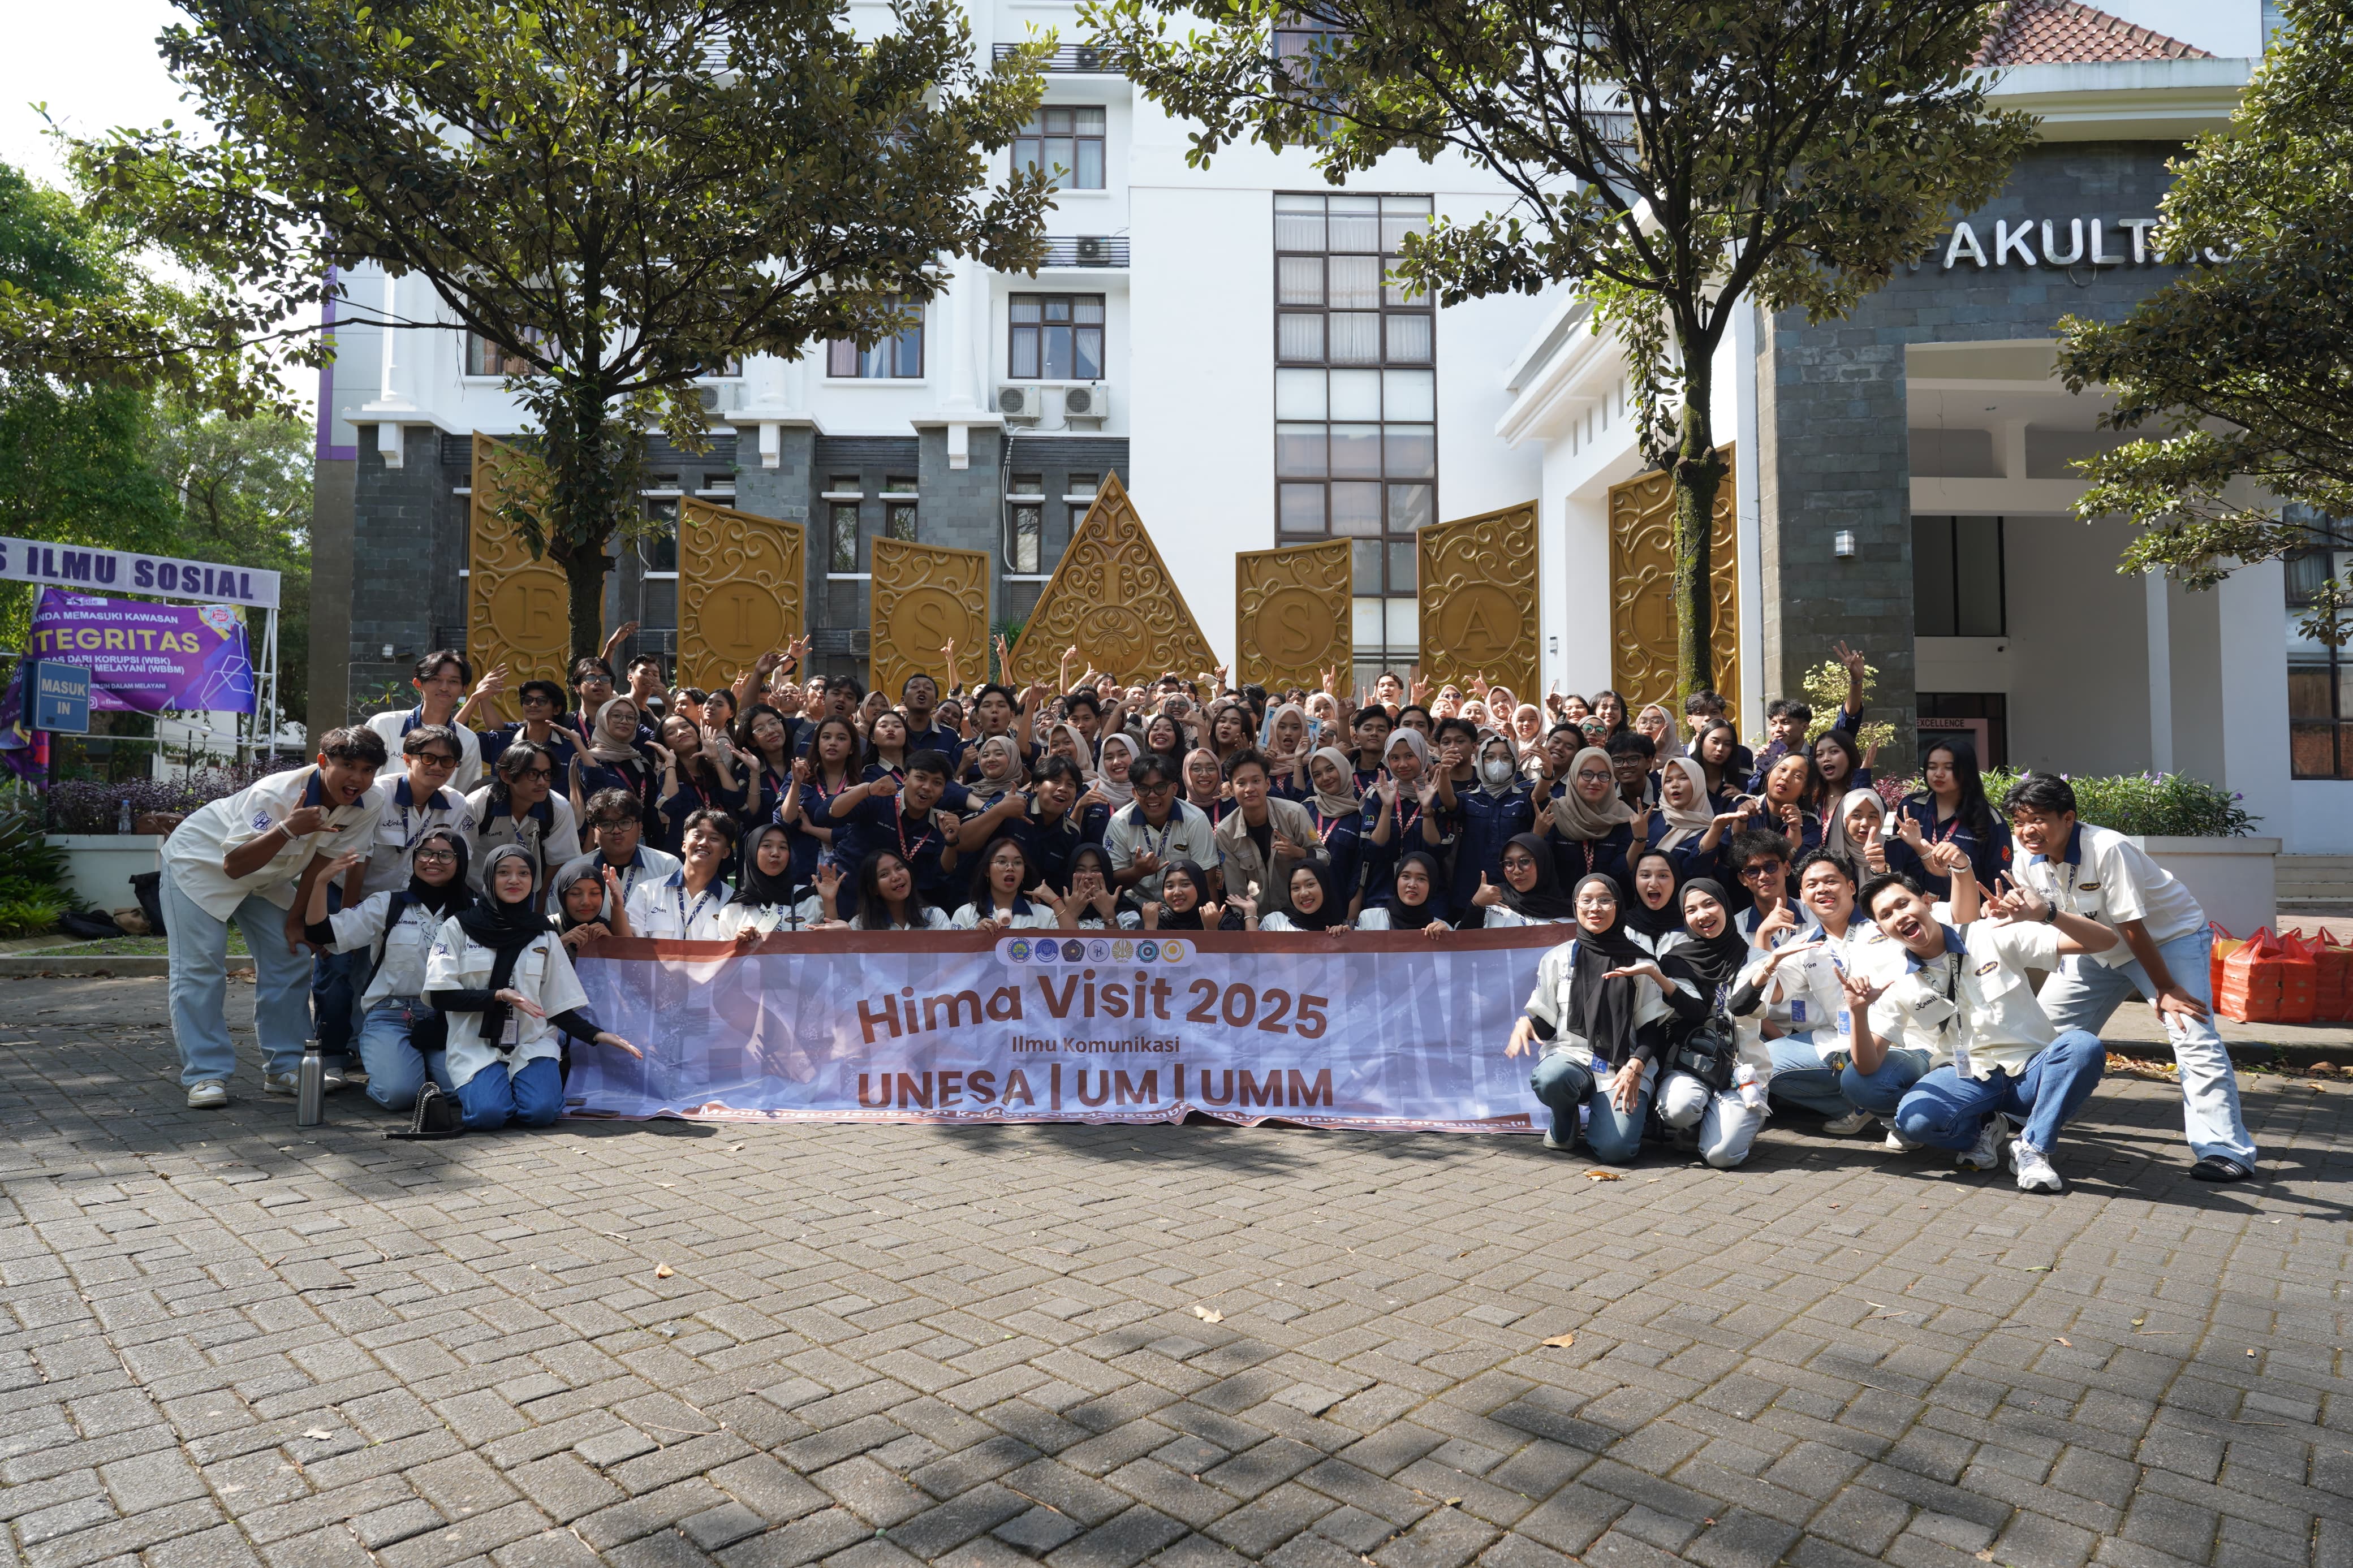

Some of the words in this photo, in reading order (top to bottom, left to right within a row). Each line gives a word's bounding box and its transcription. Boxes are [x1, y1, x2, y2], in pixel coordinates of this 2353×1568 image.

[1915, 218, 2243, 269] AKULT
[27, 546, 116, 583] ILMU
[135, 560, 253, 599] SOSIAL
[33, 611, 61, 623] ANDA
[63, 611, 122, 621] MEMASUKI
[125, 613, 178, 624] KAWASAN
[24, 628, 200, 655] NTEGRITAS
[67, 655, 92, 663] DARI
[94, 655, 139, 664] KORUPSI
[142, 656, 170, 665] (WBK)
[95, 664, 145, 672] MELAYANI
[148, 665, 185, 675] (WBBM)
[41, 679, 86, 696] MASUK
[57, 702, 71, 715] IN
[857, 987, 1023, 1044] Hima
[1038, 968, 1173, 1020] Visit
[1186, 978, 1328, 1039] 2025
[1012, 1037, 1057, 1052] Ilmu
[1063, 1036, 1180, 1053] Komunikasi
[858, 1070, 1036, 1109] UNESA
[1078, 1069, 1160, 1107] UM
[1200, 1069, 1333, 1107] UMM
[698, 1105, 837, 1117] Membangun
